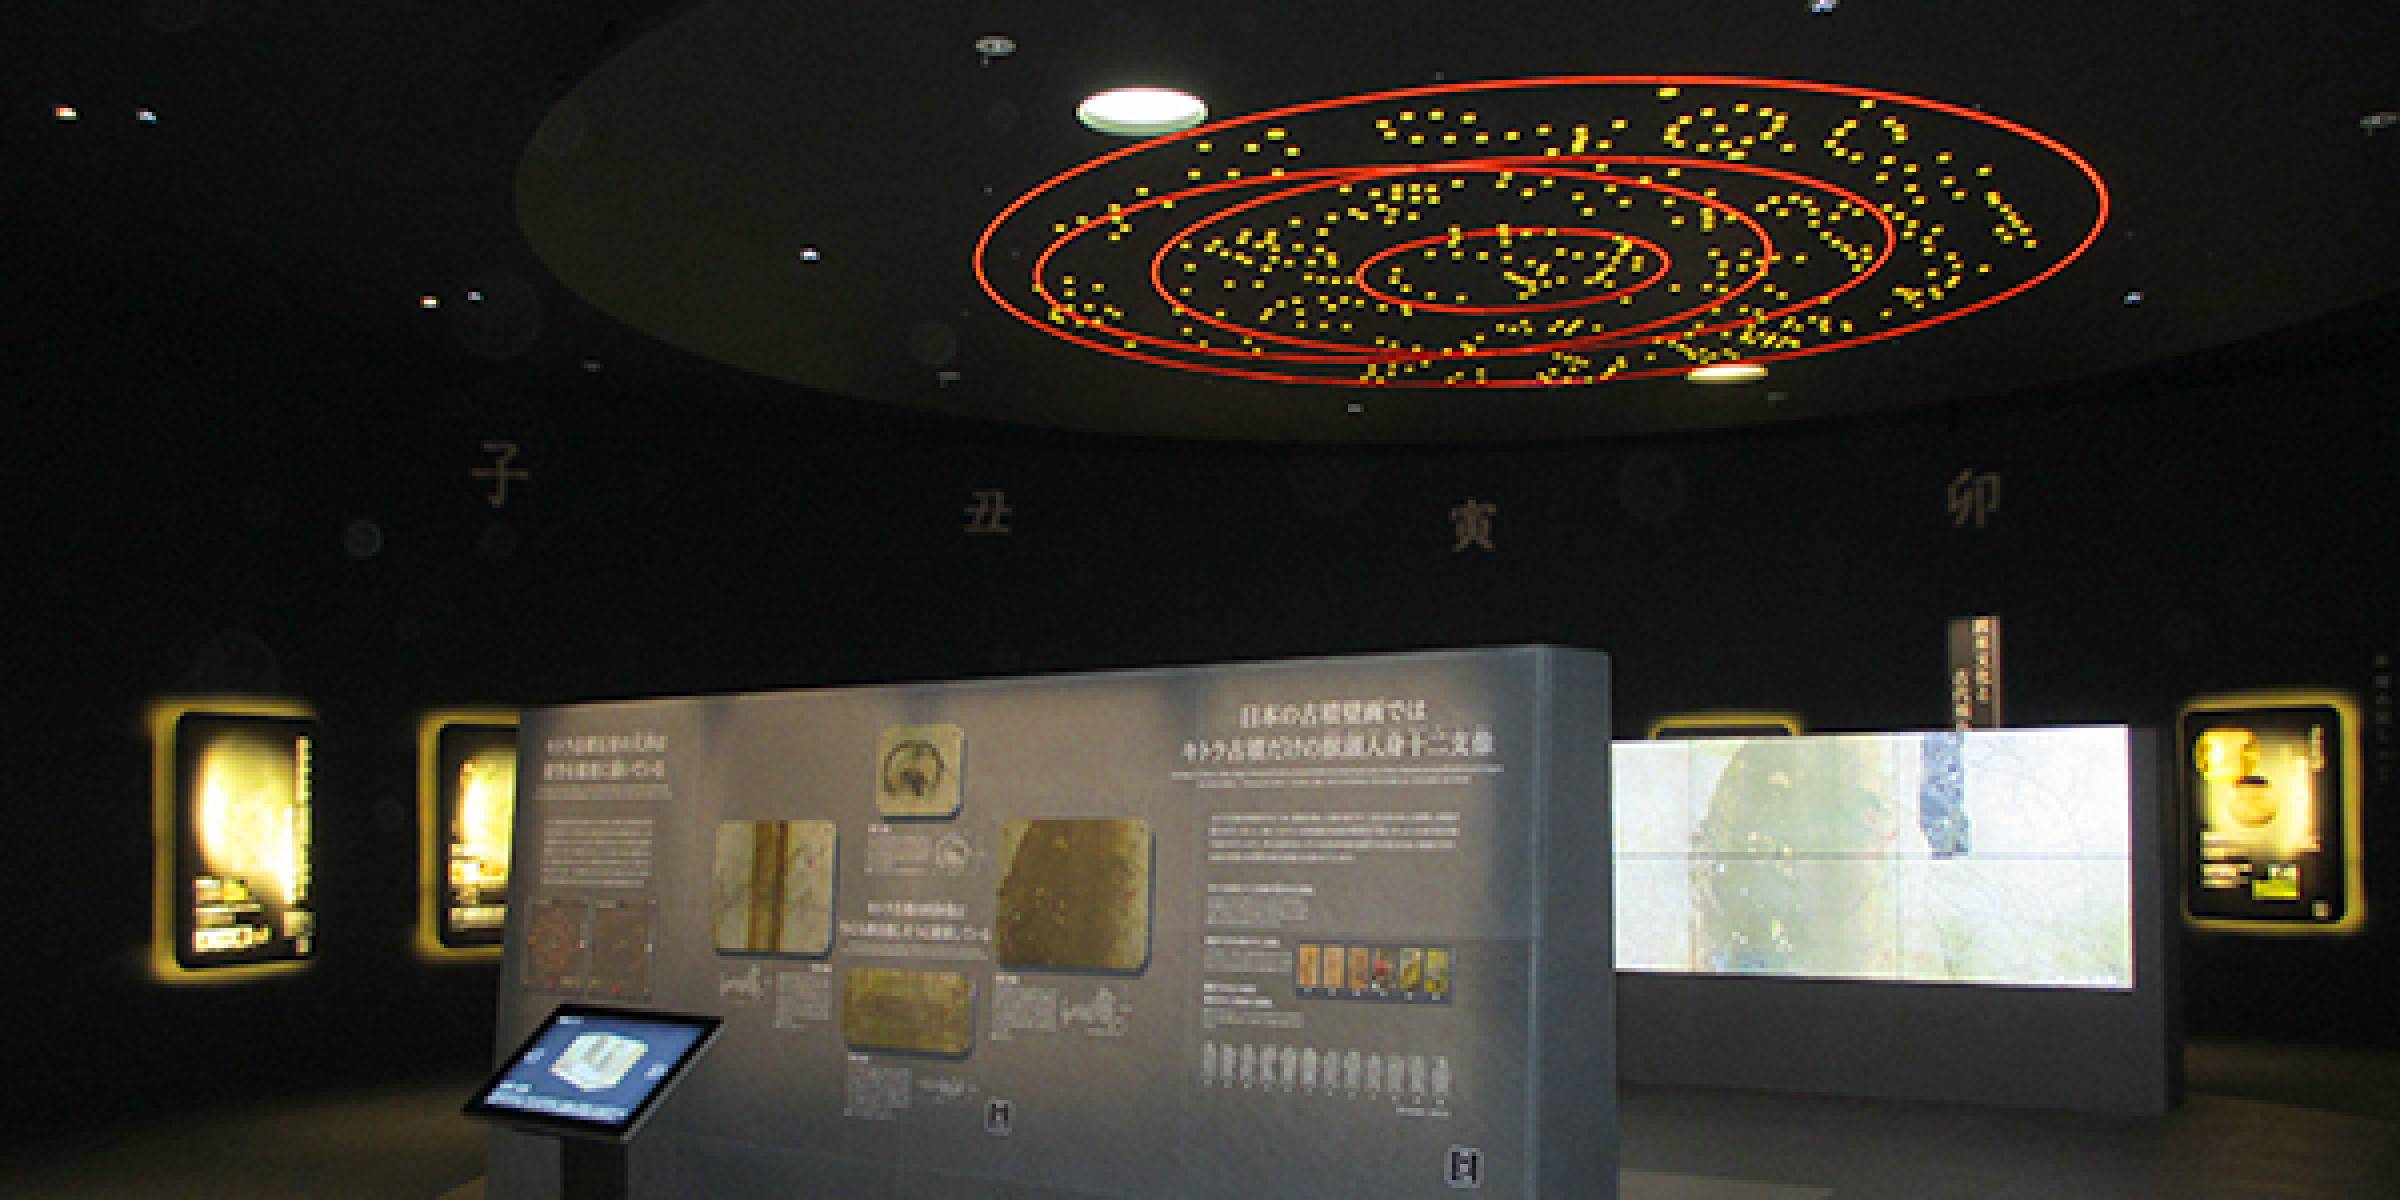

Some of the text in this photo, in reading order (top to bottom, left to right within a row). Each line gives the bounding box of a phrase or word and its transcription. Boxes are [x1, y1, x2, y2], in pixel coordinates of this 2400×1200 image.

[471, 441, 528, 508] 子
[1947, 469, 2001, 528] 卯
[964, 489, 1012, 535] 丑
[1449, 498, 1497, 552] 寅
